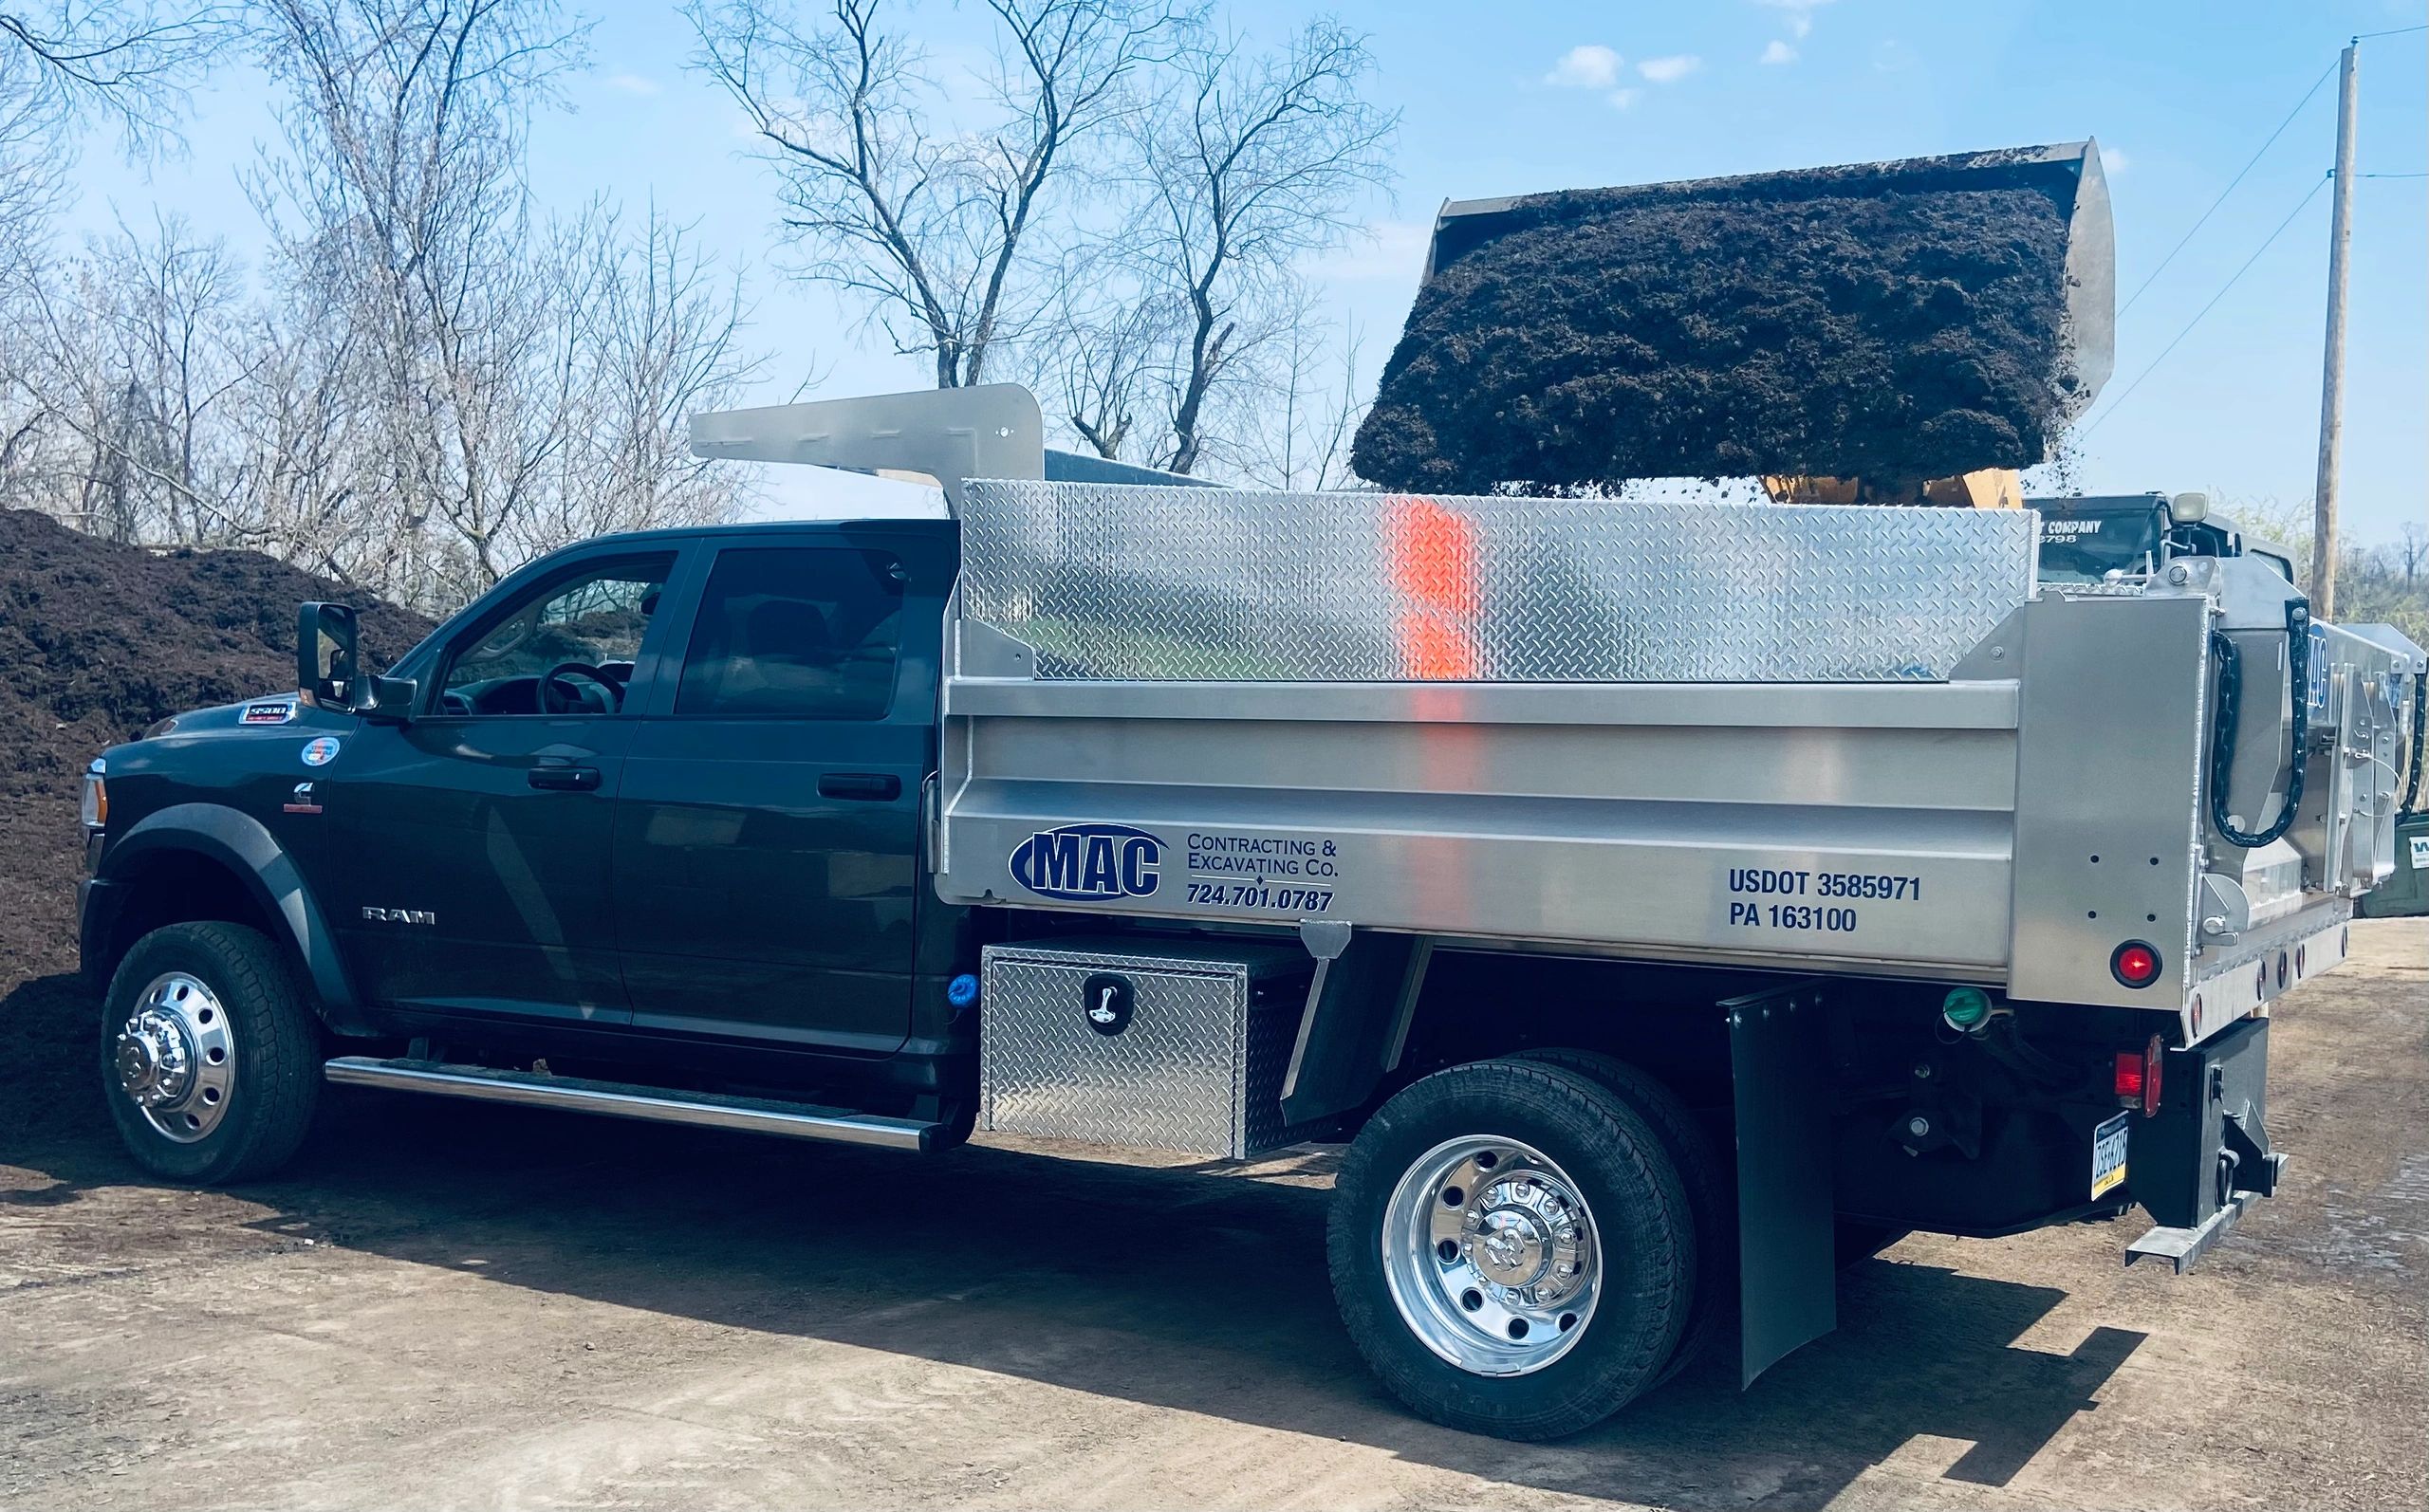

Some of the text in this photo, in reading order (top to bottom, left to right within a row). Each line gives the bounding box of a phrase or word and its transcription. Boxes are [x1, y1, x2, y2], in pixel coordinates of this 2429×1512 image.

[2048, 521, 2102, 534] COMPANY
[2308, 634, 2327, 709] AC
[1187, 833, 1338, 857] CONTRACTING &
[1031, 831, 1161, 897] MAC
[1187, 852, 1340, 877] EXCAVATING CO.
[1187, 883, 1335, 913] 724.701.0787
[1729, 868, 1920, 901] USDOT 3585971
[362, 906, 436, 926] RAM
[1730, 902, 1857, 931] PA 163100
